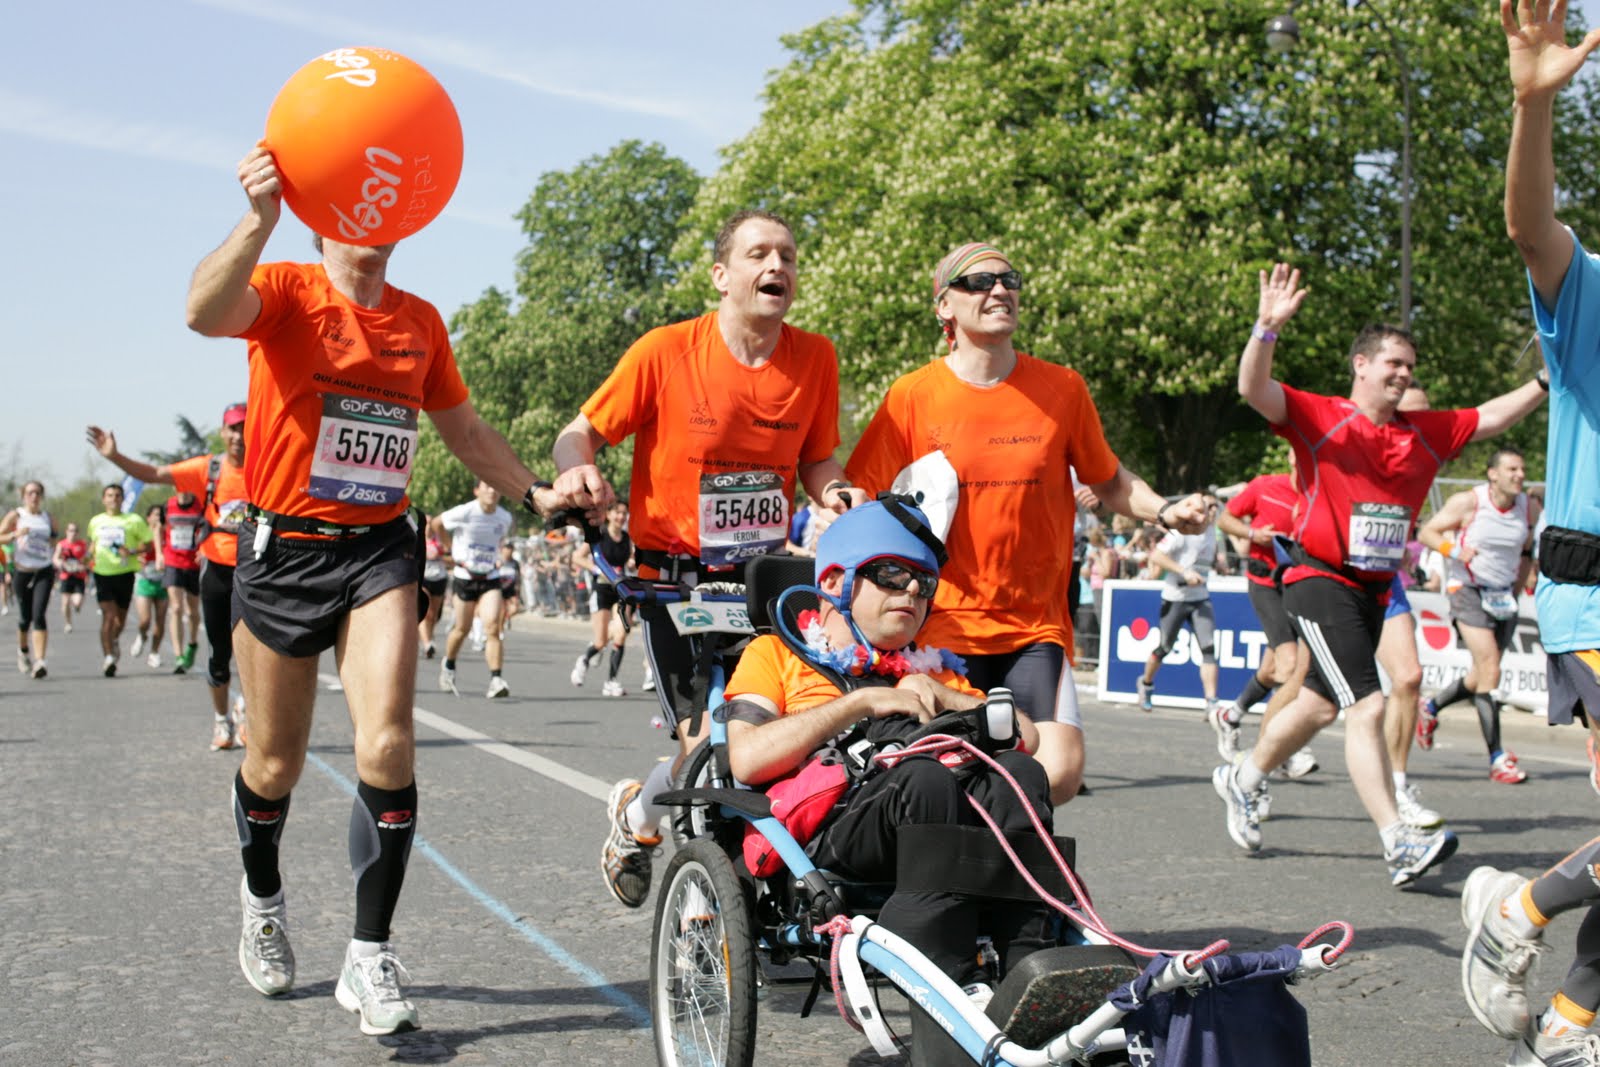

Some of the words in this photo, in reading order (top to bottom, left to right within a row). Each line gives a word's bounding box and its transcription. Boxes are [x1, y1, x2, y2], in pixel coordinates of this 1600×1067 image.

[340, 399, 371, 413] GDF
[335, 427, 410, 470] 55768
[714, 475, 742, 487] GDF
[715, 495, 783, 529] 55488
[1364, 521, 1405, 545] 27720
[1517, 671, 1549, 693] BOD
